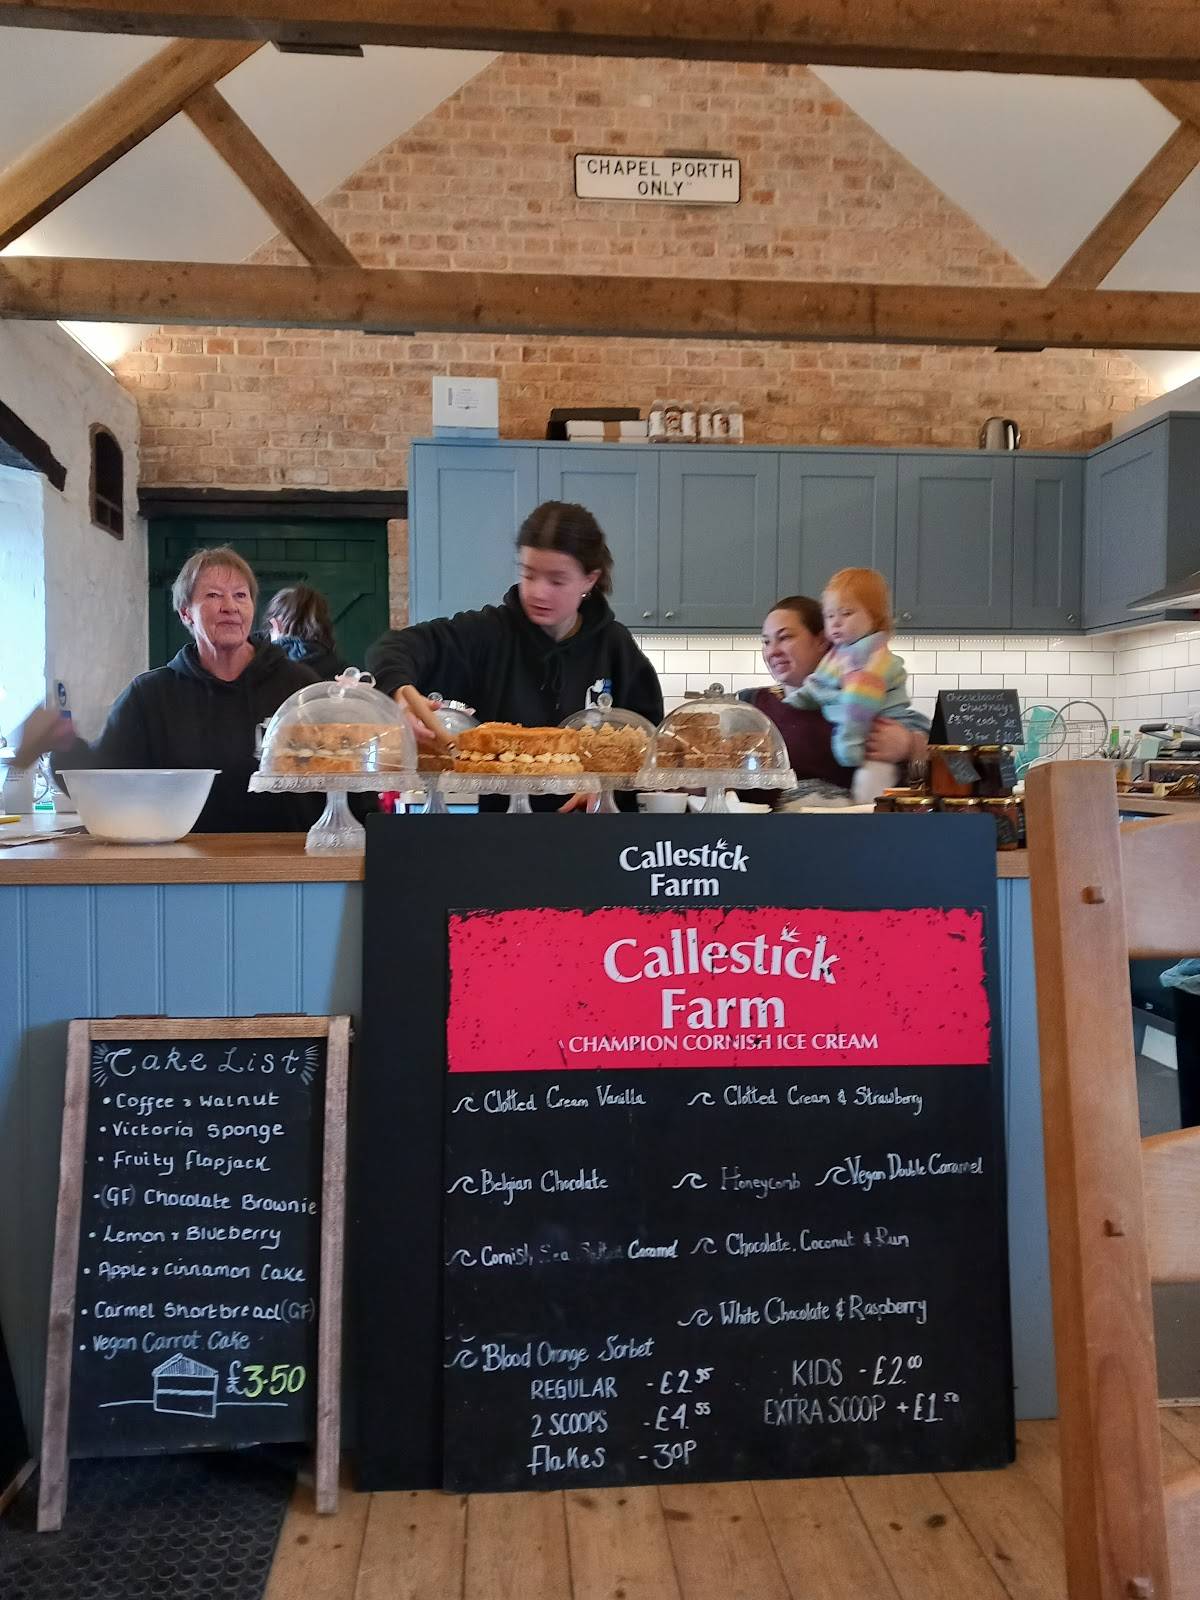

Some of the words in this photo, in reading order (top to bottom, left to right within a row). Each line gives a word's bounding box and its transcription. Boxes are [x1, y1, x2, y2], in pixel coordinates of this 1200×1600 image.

[586, 158, 661, 177] CHAPEL
[671, 162, 734, 179] PORTH
[637, 181, 684, 196] ONLY
[618, 838, 750, 873] Callestick
[650, 873, 720, 897] Farm
[603, 925, 841, 985] Callestick
[661, 988, 785, 1029] Farm
[568, 1035, 678, 1053] CHAMPION
[682, 1034, 772, 1051] CORNISH
[776, 1034, 807, 1050] ICE
[810, 1033, 879, 1049] CREAM
[103, 1047, 208, 1077] Cake
[217, 1046, 301, 1075] List
[115, 1093, 174, 1116] Coffee
[483, 1089, 537, 1113] Clotted
[546, 1084, 589, 1109] Cream
[596, 1084, 647, 1107] Vanilla
[723, 1085, 778, 1106] Clotted
[787, 1085, 830, 1105] Cream
[852, 1086, 924, 1116] Strawberry
[111, 1120, 194, 1138] Victoria
[719, 1166, 801, 1200] Honeycomb
[844, 1155, 886, 1192] Vegan
[886, 1153, 927, 1181] Double
[927, 1152, 984, 1176] Caramel
[100, 1184, 137, 1209] (GF)
[143, 1188, 233, 1211] Chocolate
[241, 1193, 318, 1216] Brownie
[480, 1168, 533, 1206] Belgian
[540, 1168, 609, 1193] Chocolate
[102, 1224, 166, 1243] Lemon
[185, 1225, 281, 1250] Blueberry
[627, 1239, 679, 1260] Caramel
[799, 1229, 854, 1252] Coconut
[98, 1260, 147, 1283] Apple
[163, 1258, 251, 1280] Cinnamon
[261, 1263, 307, 1283] Cake
[94, 1301, 155, 1320] Carmel
[280, 1298, 316, 1324] (GF)
[719, 1300, 760, 1326] White
[763, 1296, 831, 1325] Chocolate
[849, 1294, 927, 1325] Raspberry
[92, 1333, 137, 1360] Vegan
[142, 1330, 201, 1353] Carrot
[206, 1330, 250, 1352] Cake
[481, 1343, 532, 1372] Blood
[536, 1341, 590, 1371] Orange
[598, 1334, 655, 1362] Sorbet
[226, 1360, 307, 1398] £3.50
[791, 1358, 844, 1387] KIDS
[530, 1376, 618, 1400] REGULAR
[530, 1414, 542, 1438] 2
[549, 1410, 609, 1436] SCOOPS
[764, 1398, 824, 1426] EXTRA
[828, 1394, 886, 1424] SCOOP
